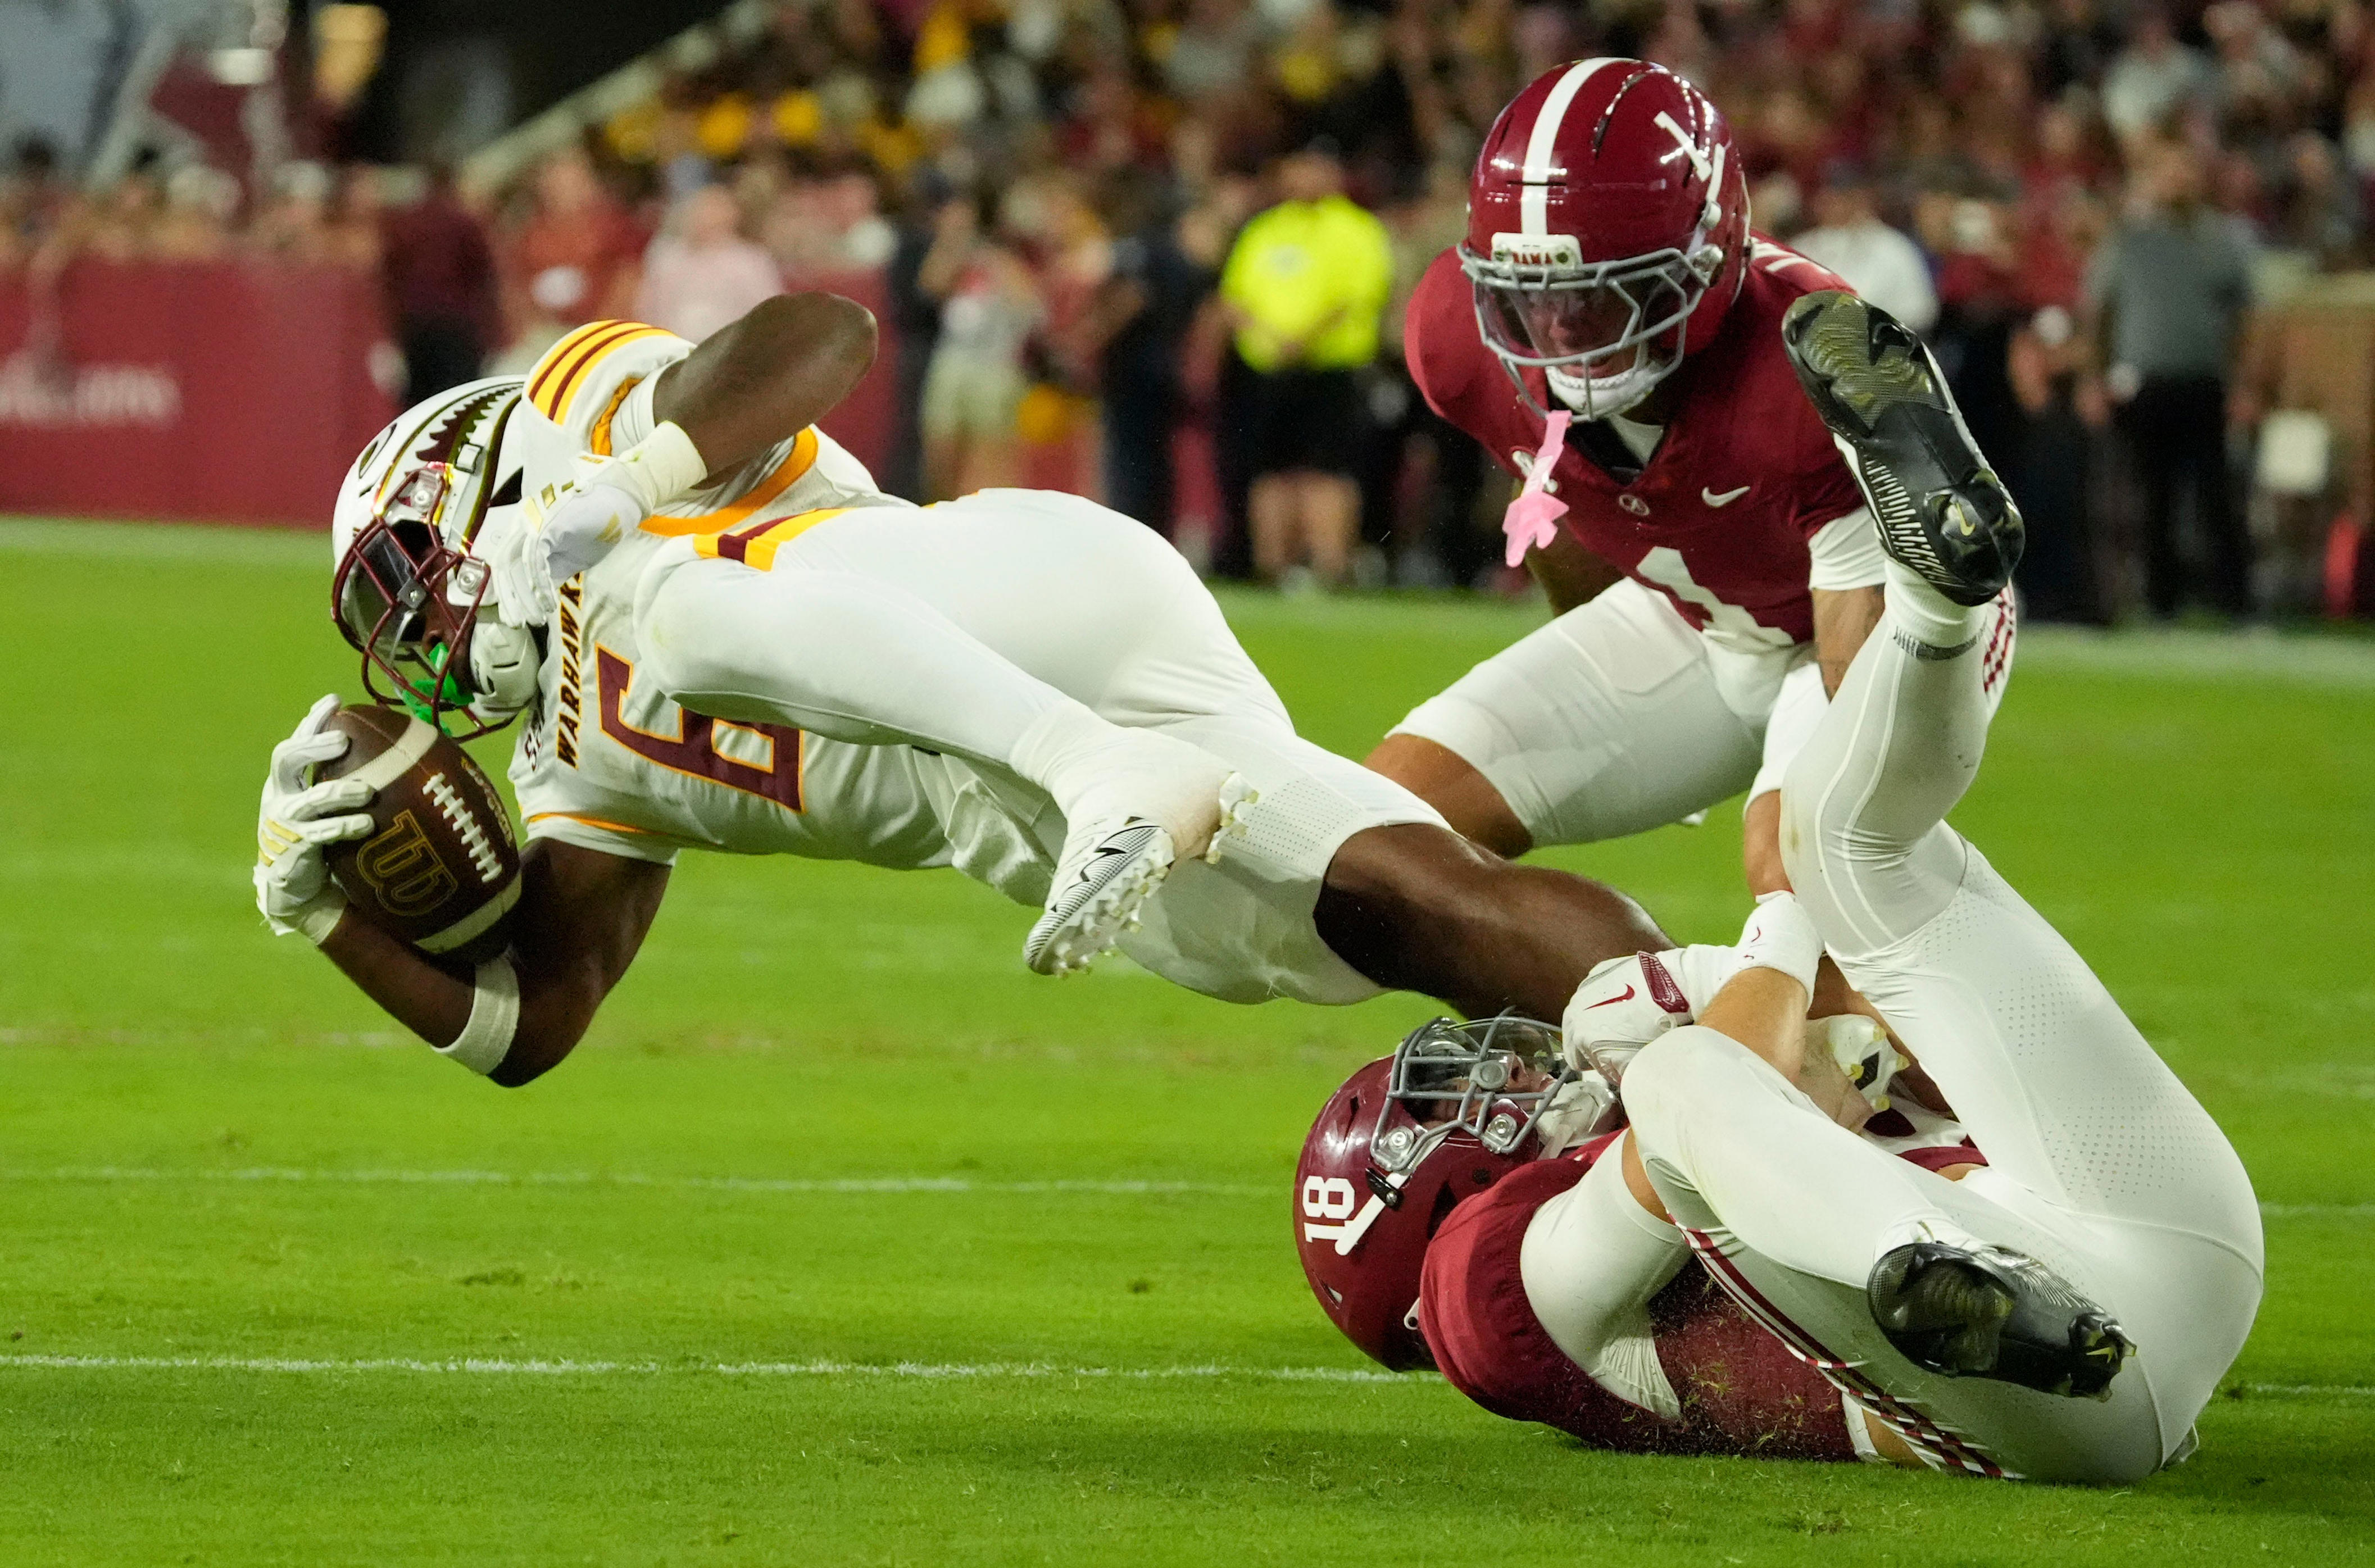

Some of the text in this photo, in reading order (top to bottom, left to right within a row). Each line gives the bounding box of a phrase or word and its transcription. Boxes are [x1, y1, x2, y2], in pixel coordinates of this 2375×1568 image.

[556, 570, 583, 771] WARHAWK
[594, 641, 807, 815] 6
[1302, 1175, 1355, 1243] 18
